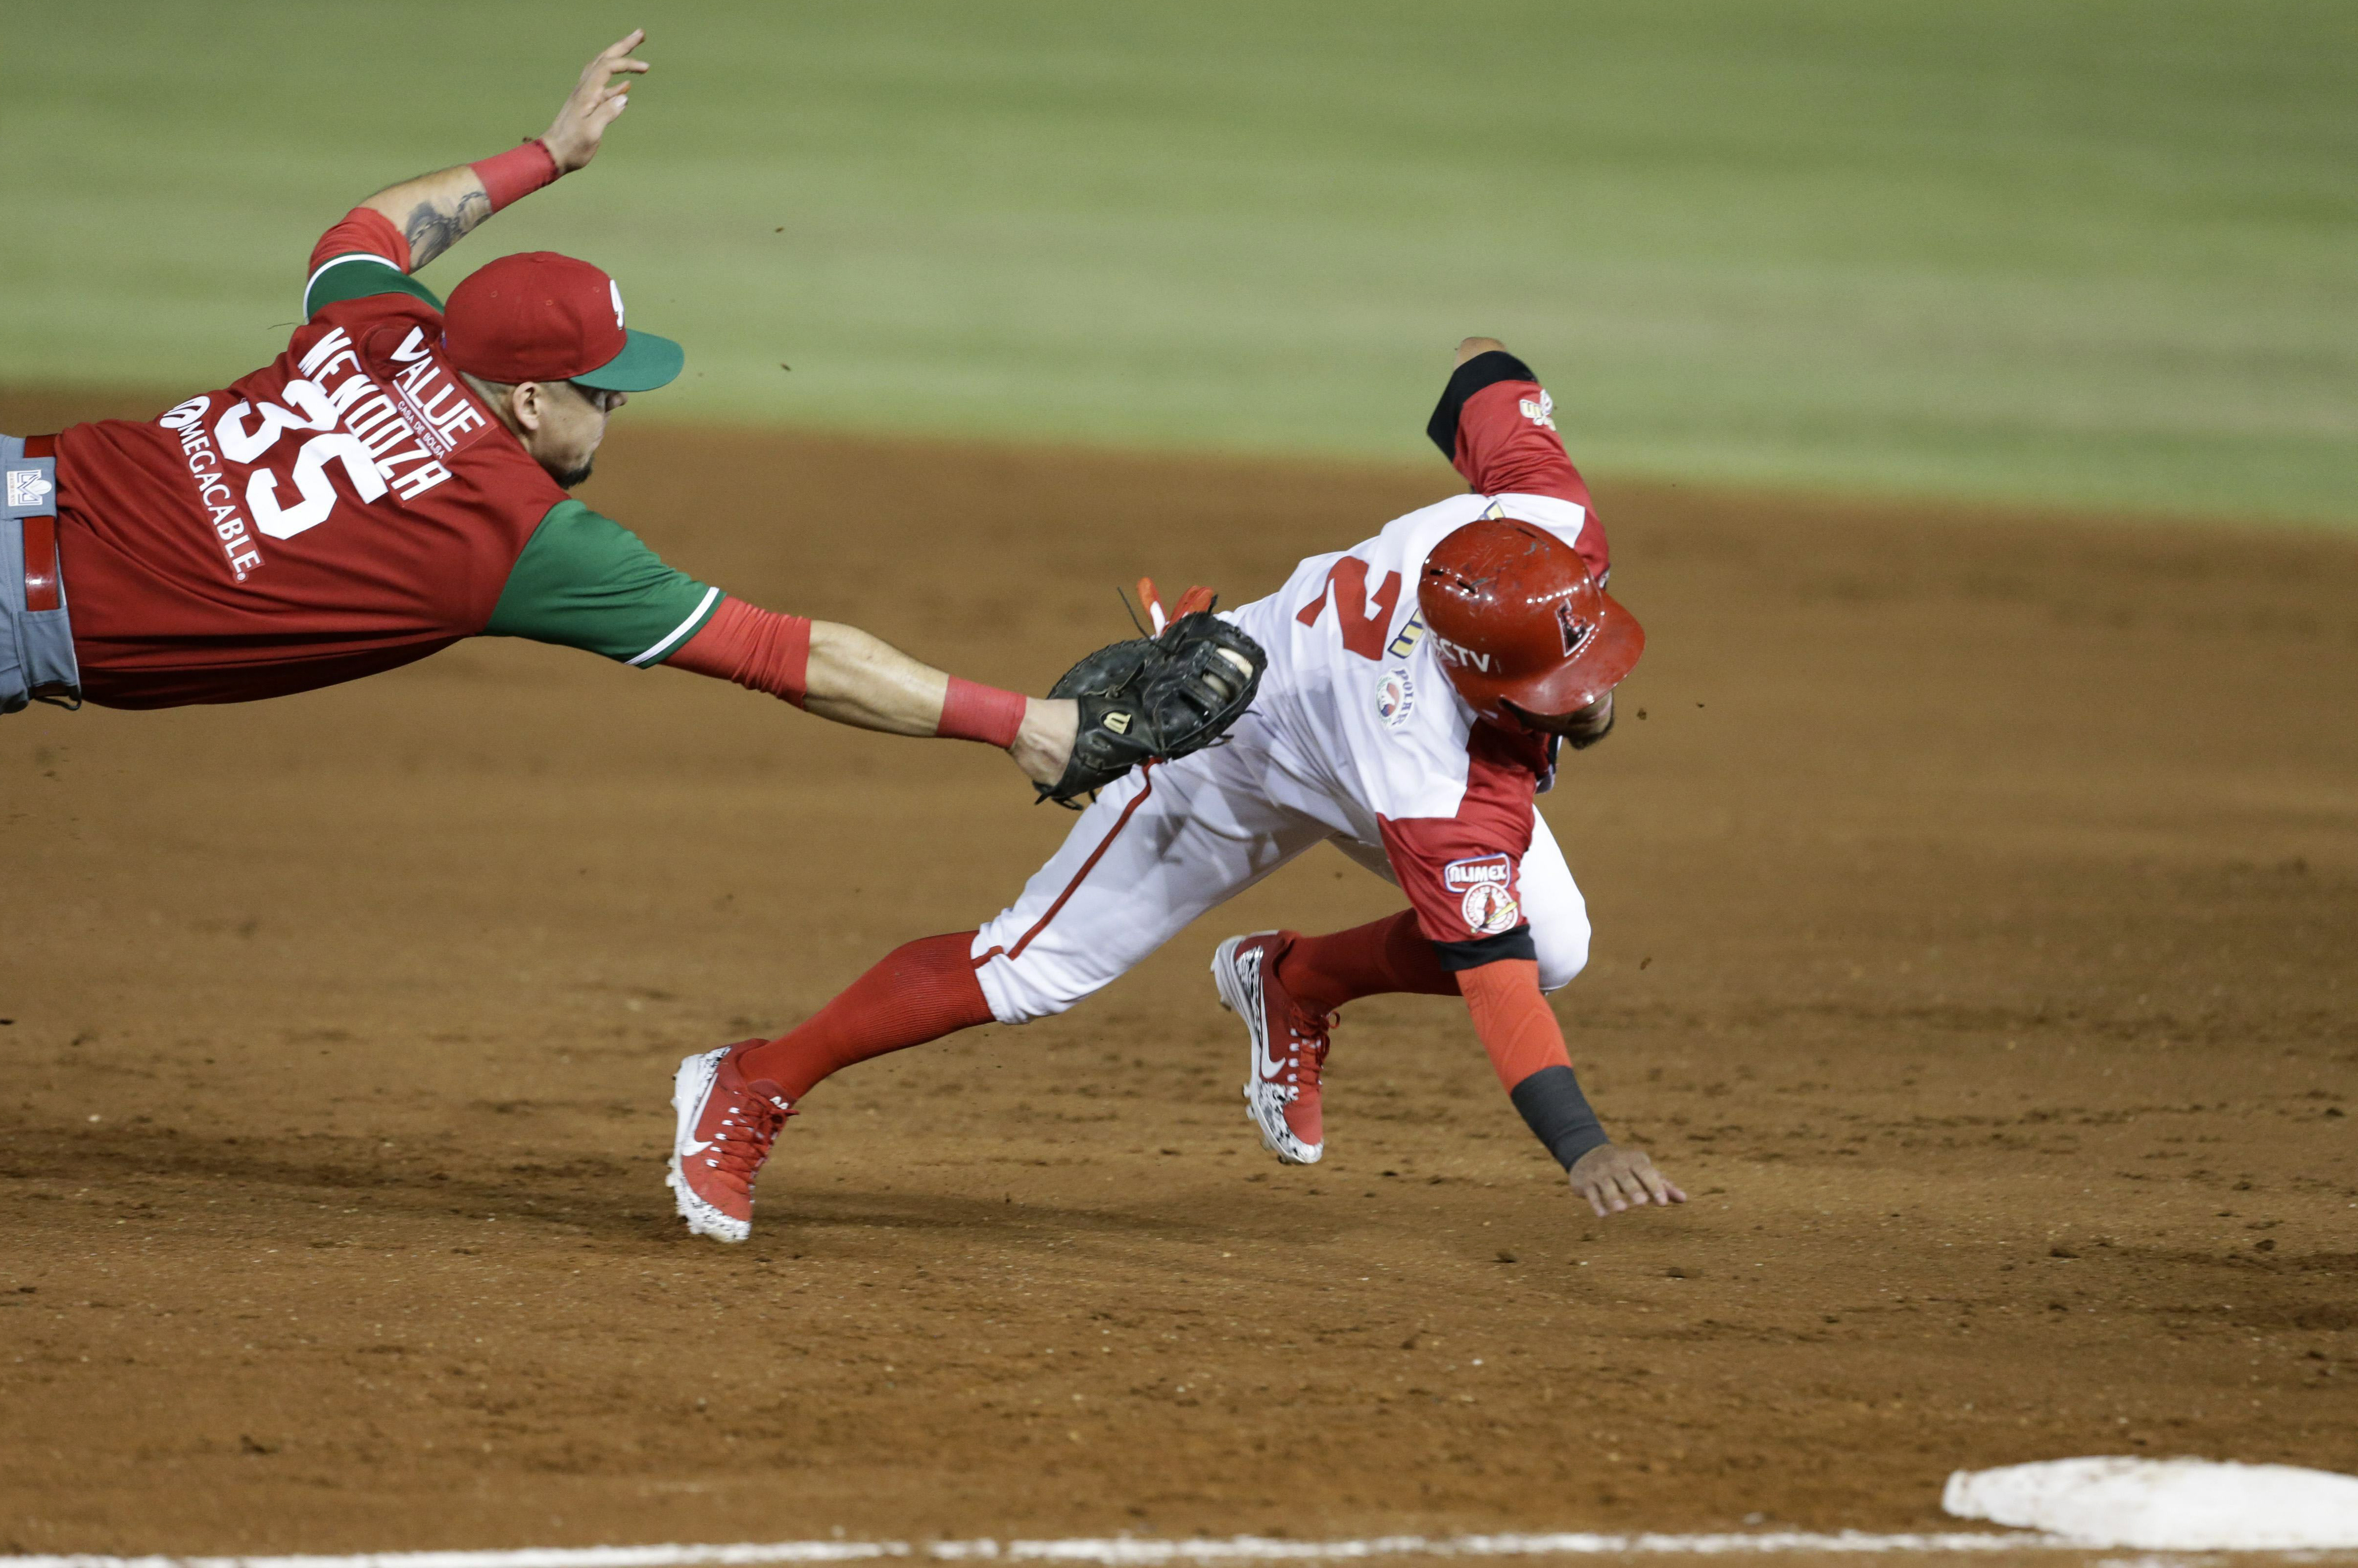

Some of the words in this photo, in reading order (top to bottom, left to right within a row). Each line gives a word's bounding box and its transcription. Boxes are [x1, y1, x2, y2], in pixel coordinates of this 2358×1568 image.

[297, 326, 452, 501] MENDOZA
[390, 325, 486, 447] VALUE
[397, 400, 414, 424] CASA
[413, 421, 426, 435] DE
[422, 432, 446, 459] BOLSA
[177, 420, 261, 574] MEGACABLE
[214, 379, 389, 540] 35
[1296, 555, 1402, 661] 2
[1391, 669, 1414, 725] POLAR
[1449, 864, 1507, 883] ALIMEX
